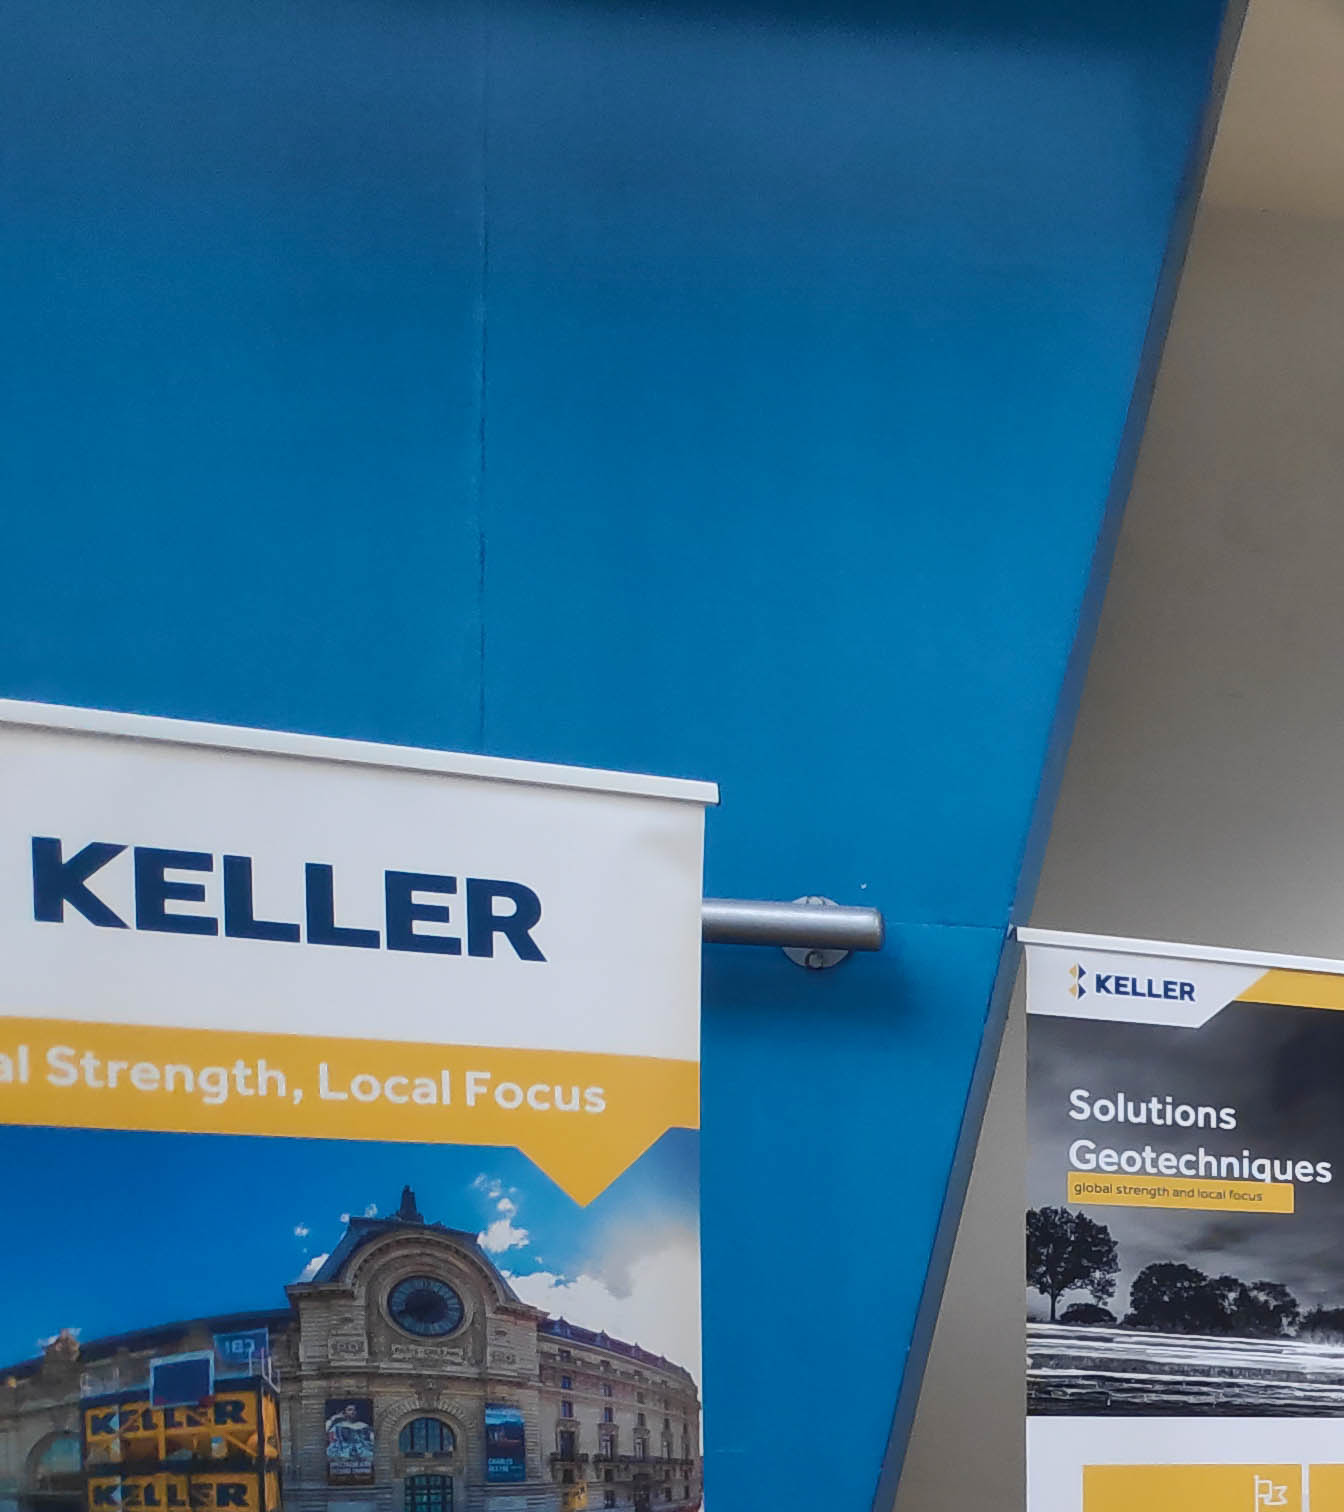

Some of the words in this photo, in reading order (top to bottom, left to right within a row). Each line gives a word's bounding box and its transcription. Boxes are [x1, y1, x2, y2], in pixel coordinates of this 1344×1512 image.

[31, 836, 547, 962] KELLER
[1094, 972, 1196, 1003] KELLER
[46, 1046, 303, 1105] Strength,
[319, 1063, 451, 1107] Local
[465, 1071, 606, 1113] Focus
[1068, 1088, 1237, 1131] Solutions
[1068, 1138, 1333, 1184] Geotechniques
[1072, 1181, 1113, 1196] global
[1114, 1183, 1170, 1202] strength
[1172, 1188, 1195, 1199] and
[1197, 1187, 1226, 1201] local
[1229, 1188, 1263, 1202] focus
